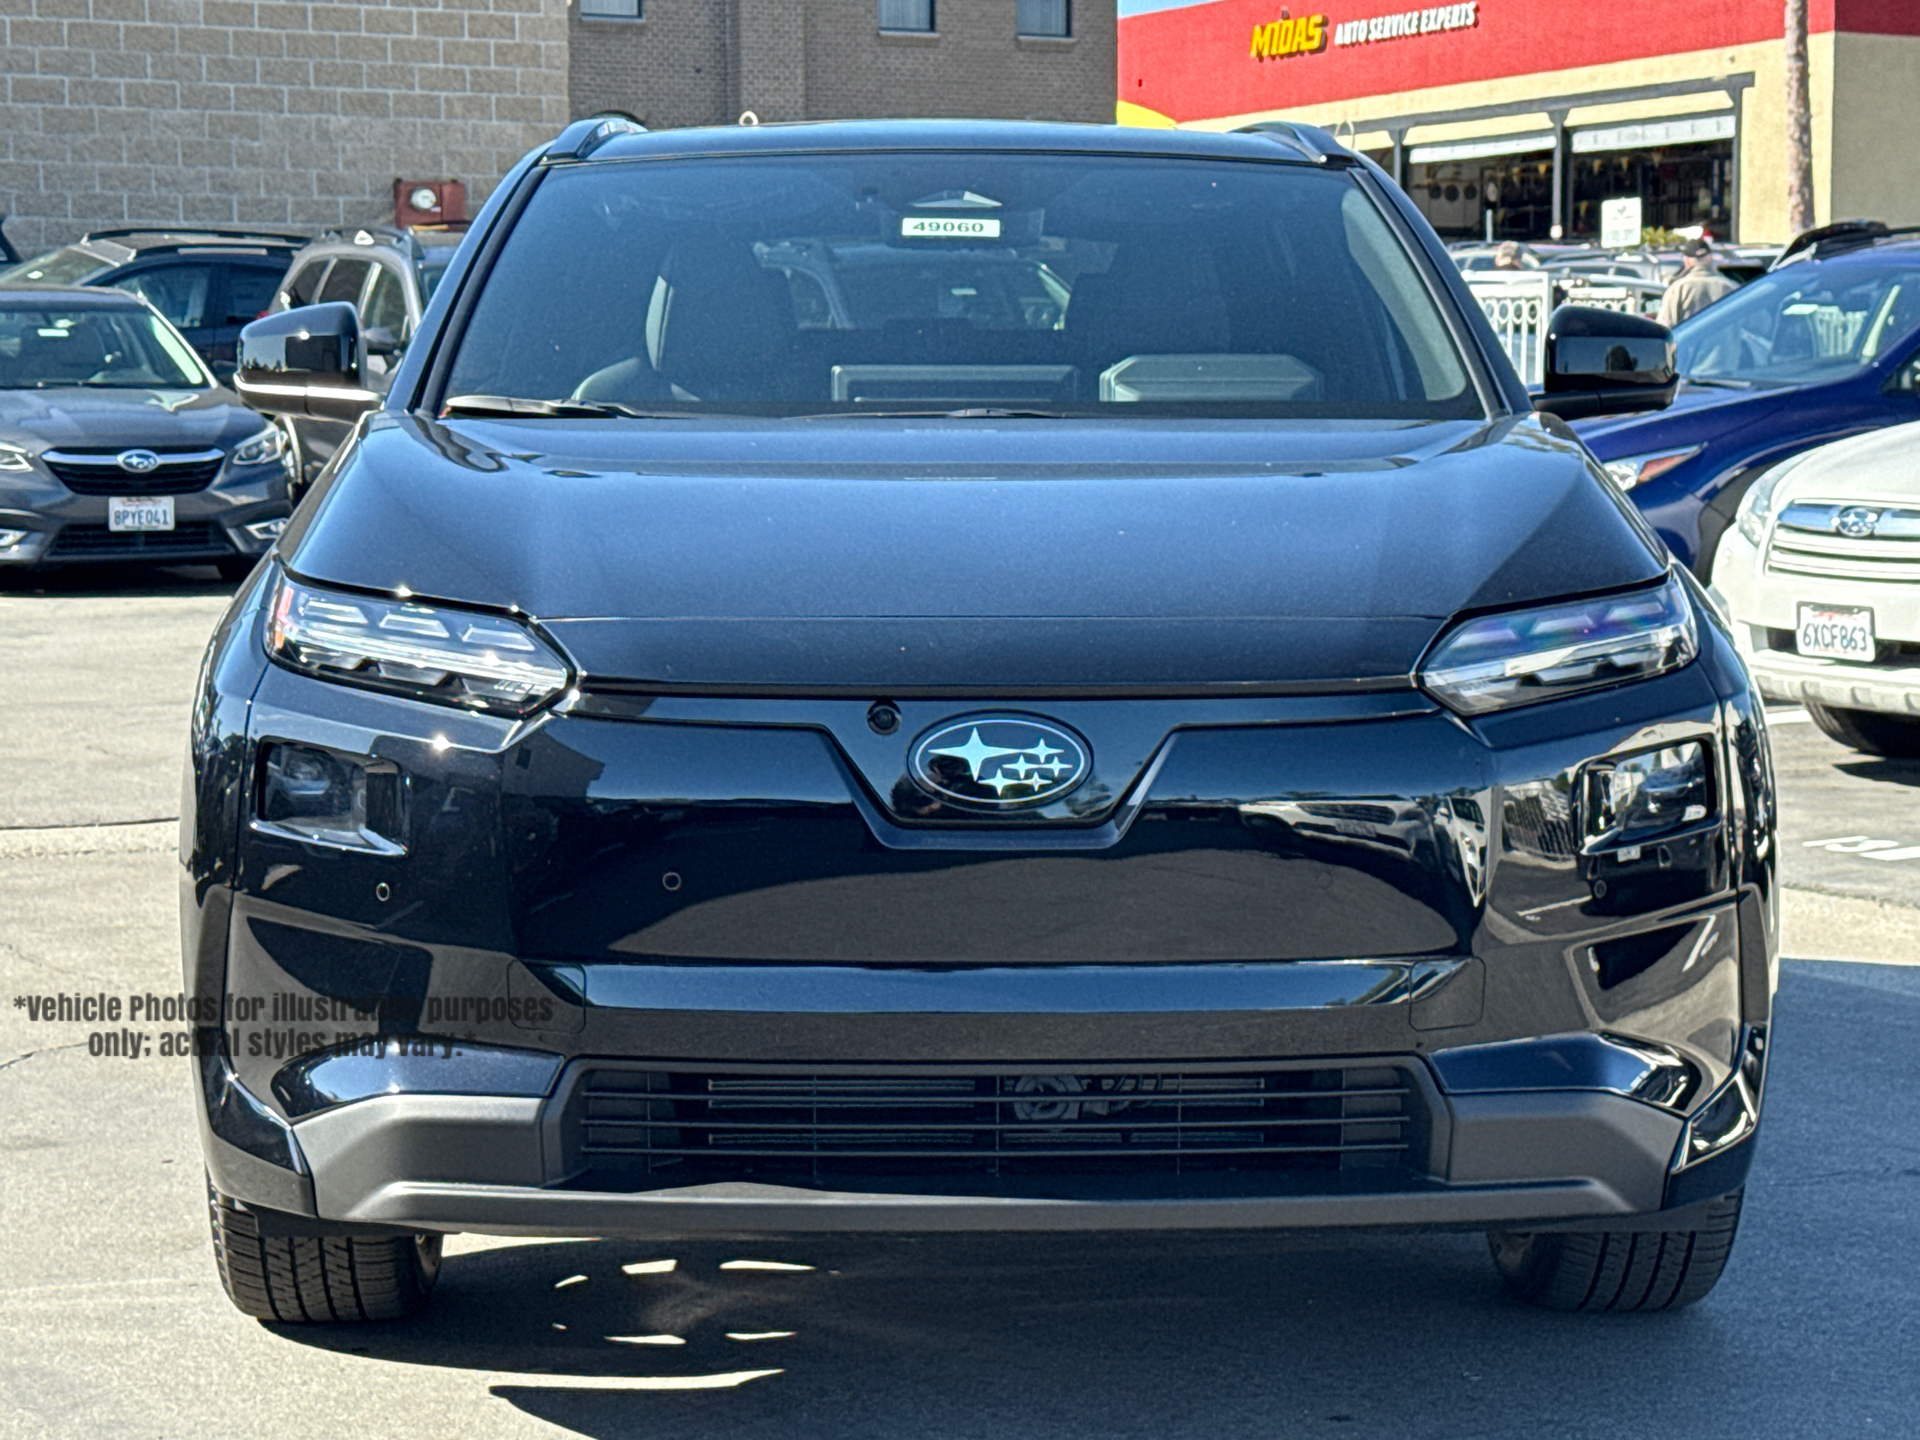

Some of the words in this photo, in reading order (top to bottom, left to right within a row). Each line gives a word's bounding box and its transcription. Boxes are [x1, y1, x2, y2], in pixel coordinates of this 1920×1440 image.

[1251, 14, 1325, 58] MIDAS
[1334, 20, 1369, 45] AUTO
[1369, 11, 1419, 41] SERVICE
[1420, 1, 1477, 34] EXPERTS
[912, 221, 985, 233] 49060
[113, 509, 170, 526] 8PYE041
[1803, 622, 1868, 652] 6XCF863
